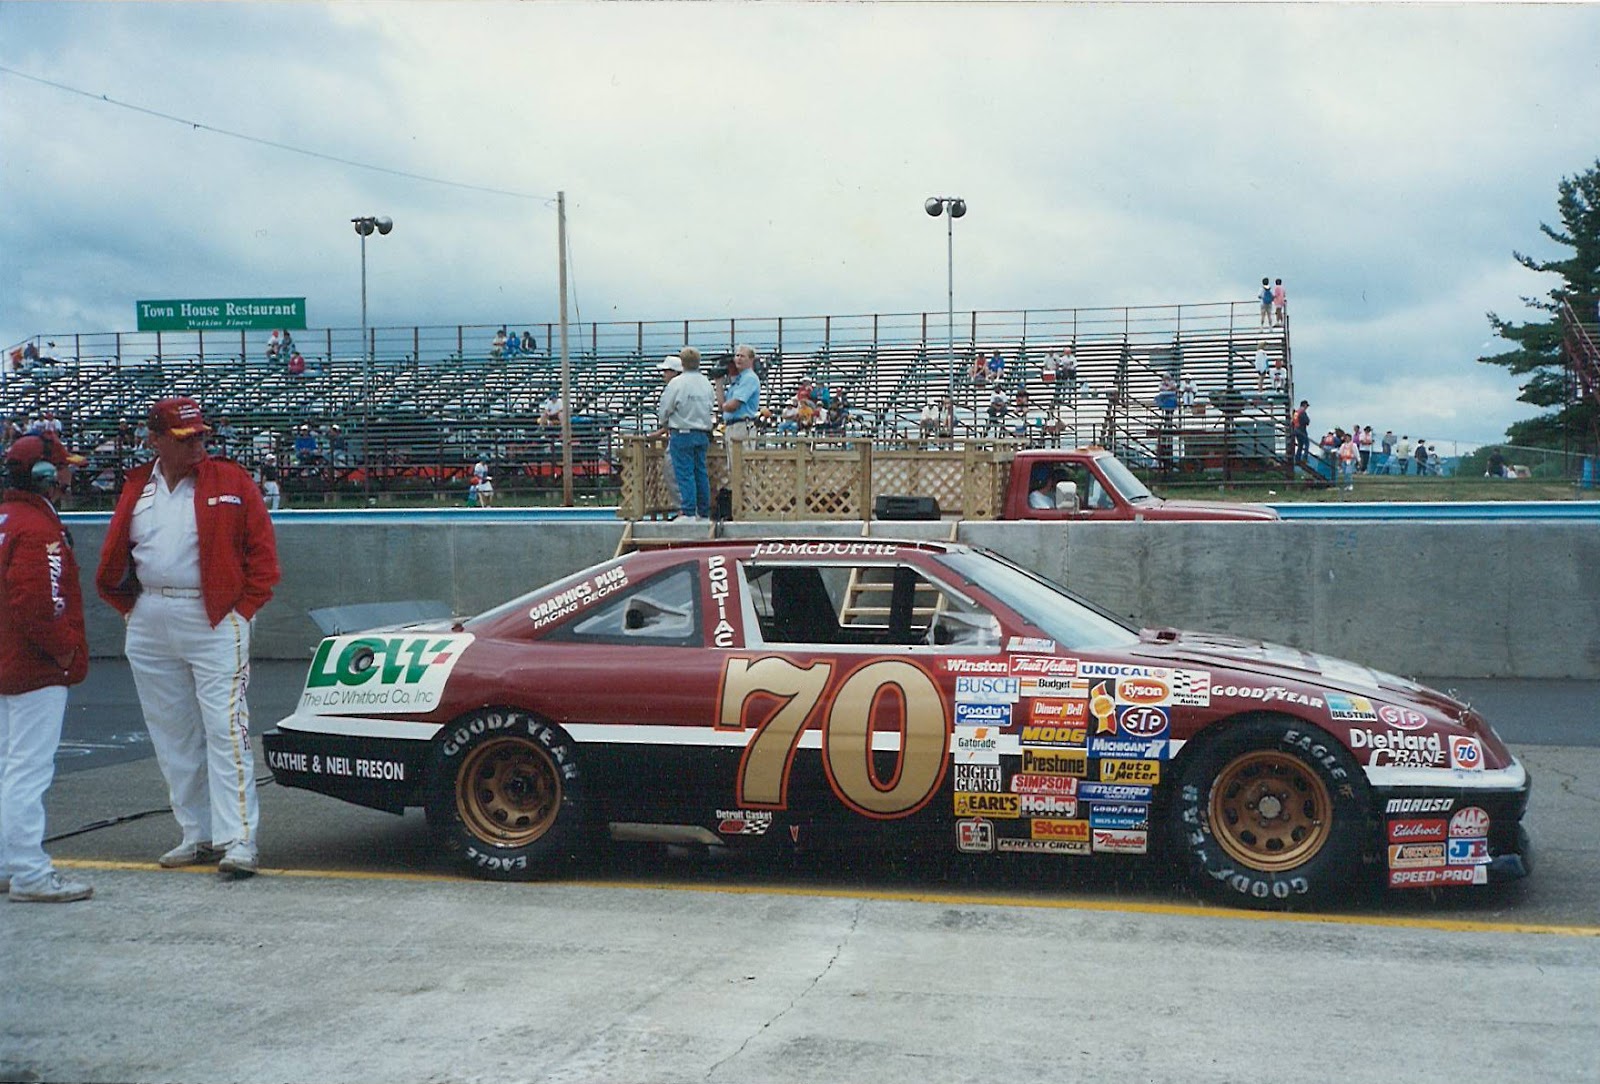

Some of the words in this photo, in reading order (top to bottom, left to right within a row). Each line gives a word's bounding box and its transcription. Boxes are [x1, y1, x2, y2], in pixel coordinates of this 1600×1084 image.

[142, 304, 174, 317] Town
[181, 303, 219, 317] House
[226, 302, 296, 316] Restaurant
[529, 581, 592, 621] GRAPHICS
[594, 566, 626, 589] PLUS
[709, 555, 735, 647] PONTIAC
[534, 603, 579, 629] RACING
[582, 577, 630, 605] DECALS
[947, 660, 1008, 672] Winston
[1012, 658, 1042, 672] True
[1035, 659, 1077, 673] Value
[1082, 665, 1152, 677] UNOCAL
[958, 678, 1017, 693] BUSCH
[1038, 678, 1070, 690] Budget
[1122, 682, 1163, 698] Tyson
[303, 692, 322, 706] The
[342, 691, 389, 704] Whitford
[1211, 685, 1324, 709] GOODYEAR
[958, 705, 1010, 718] Goody's
[1035, 702, 1063, 714] Dinner
[1066, 703, 1084, 715] Bell
[1332, 711, 1376, 719] BILSTEIN
[1386, 708, 1421, 724] STP
[1126, 709, 1162, 730] STP
[714, 655, 952, 820] 70
[1021, 726, 1086, 742] MOOG
[1350, 729, 1441, 752] DieHard
[958, 737, 996, 749] Gatorade
[1092, 739, 1146, 752] MICHIGAN
[1283, 730, 1347, 780] EAGLE
[1369, 748, 1447, 767] CRANE
[1458, 745, 1477, 760] 76
[269, 751, 307, 771] KATHIE
[312, 756, 321, 772] &
[326, 756, 352, 775] NEIL
[356, 759, 404, 780] FRESON
[1023, 750, 1084, 773] Prestone
[1119, 762, 1151, 770] Auto
[957, 765, 999, 779] RIGHT
[1115, 771, 1157, 780] Meter
[956, 779, 999, 792] GUARD
[1016, 776, 1071, 789] SIMPSON
[969, 796, 1018, 811] EARL'S
[1022, 795, 1076, 816] Holley
[1093, 804, 1146, 814] GOODYEAR
[1386, 799, 1455, 813] MOROSO
[716, 810, 744, 819] Detroit
[746, 810, 772, 820] Gasket
[1393, 824, 1442, 837] Edelbrock
[1001, 841, 1047, 849] PERFECT
[1049, 842, 1085, 850] CIRCLE
[1450, 841, 1487, 857] JE
[466, 847, 527, 872] EAGLE
[1391, 870, 1473, 884] SPEED-PRO
